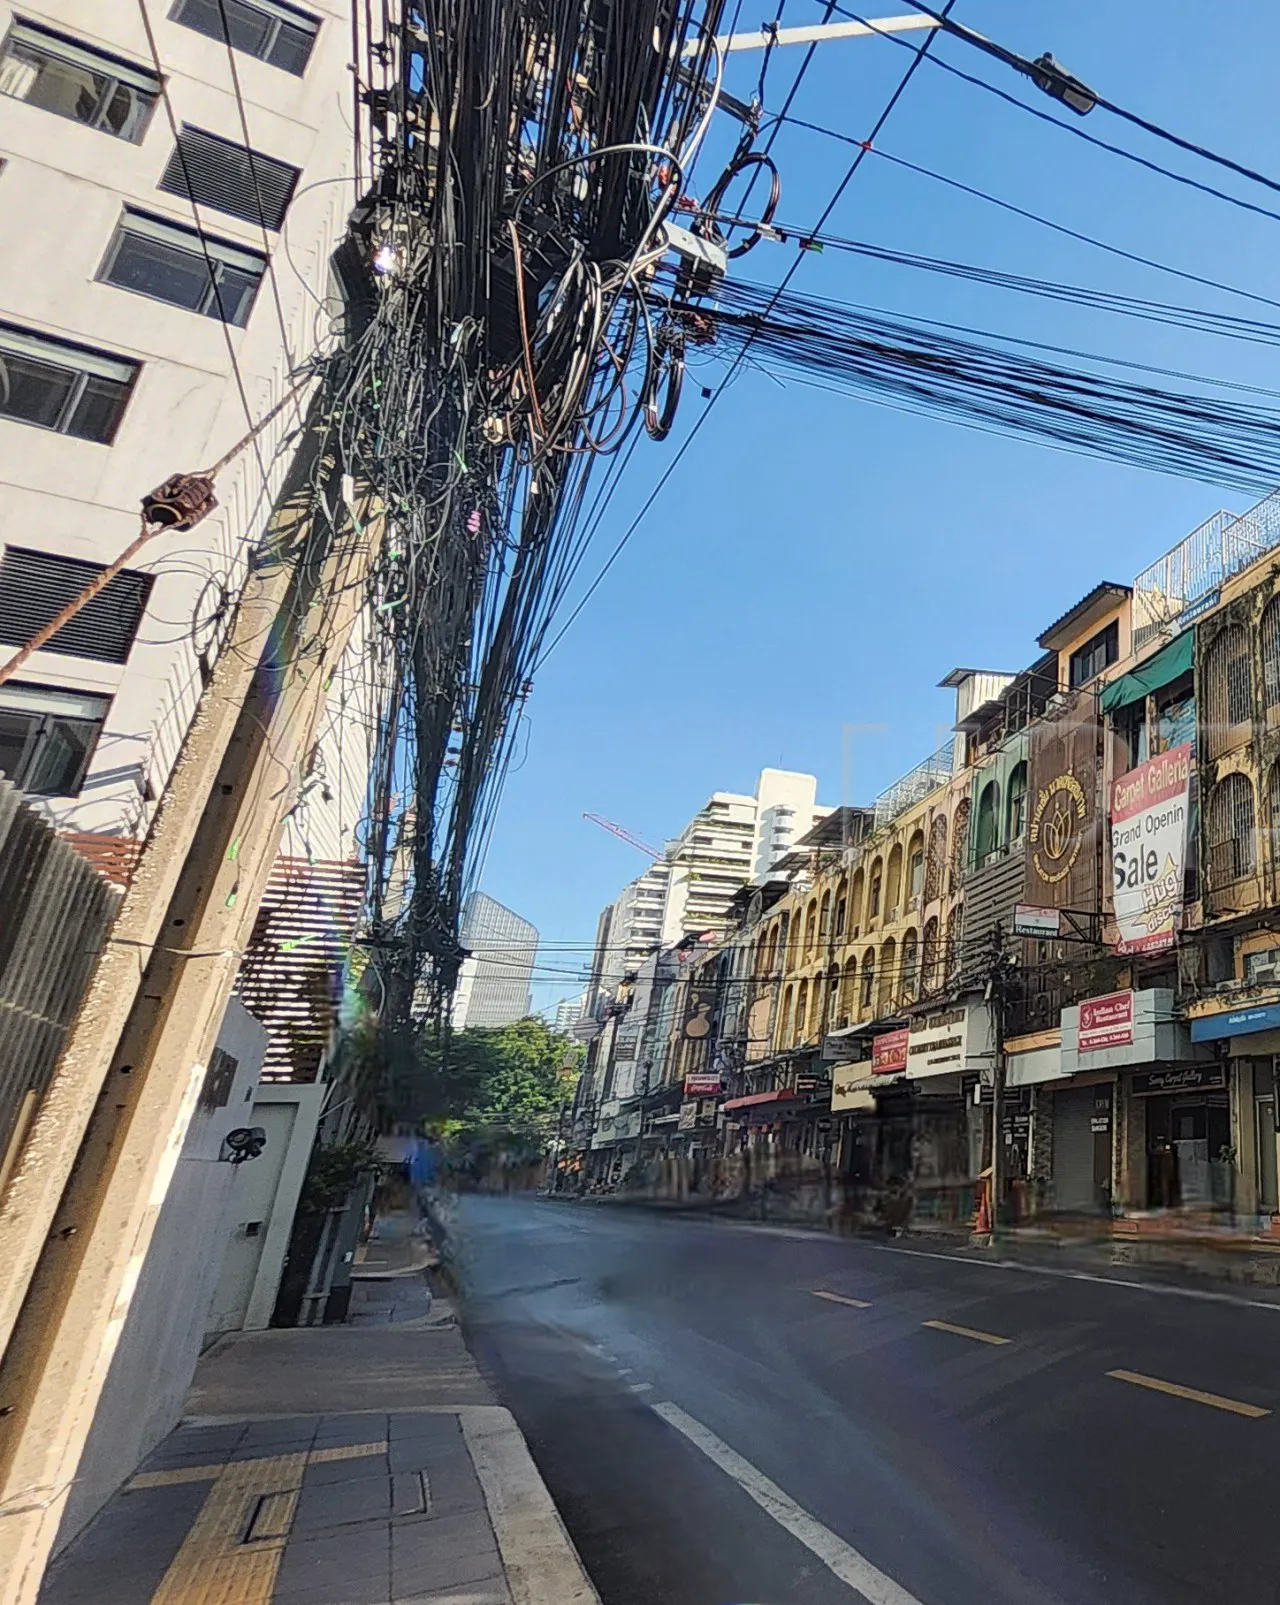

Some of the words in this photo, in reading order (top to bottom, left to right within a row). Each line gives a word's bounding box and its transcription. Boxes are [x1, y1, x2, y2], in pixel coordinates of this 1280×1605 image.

[1114, 774, 1145, 812] Carpet
[1147, 752, 1189, 795] Galleria
[1112, 825, 1141, 848] Grand
[1113, 844, 1158, 889] Sale
[1015, 925, 1058, 937] Restaurant
